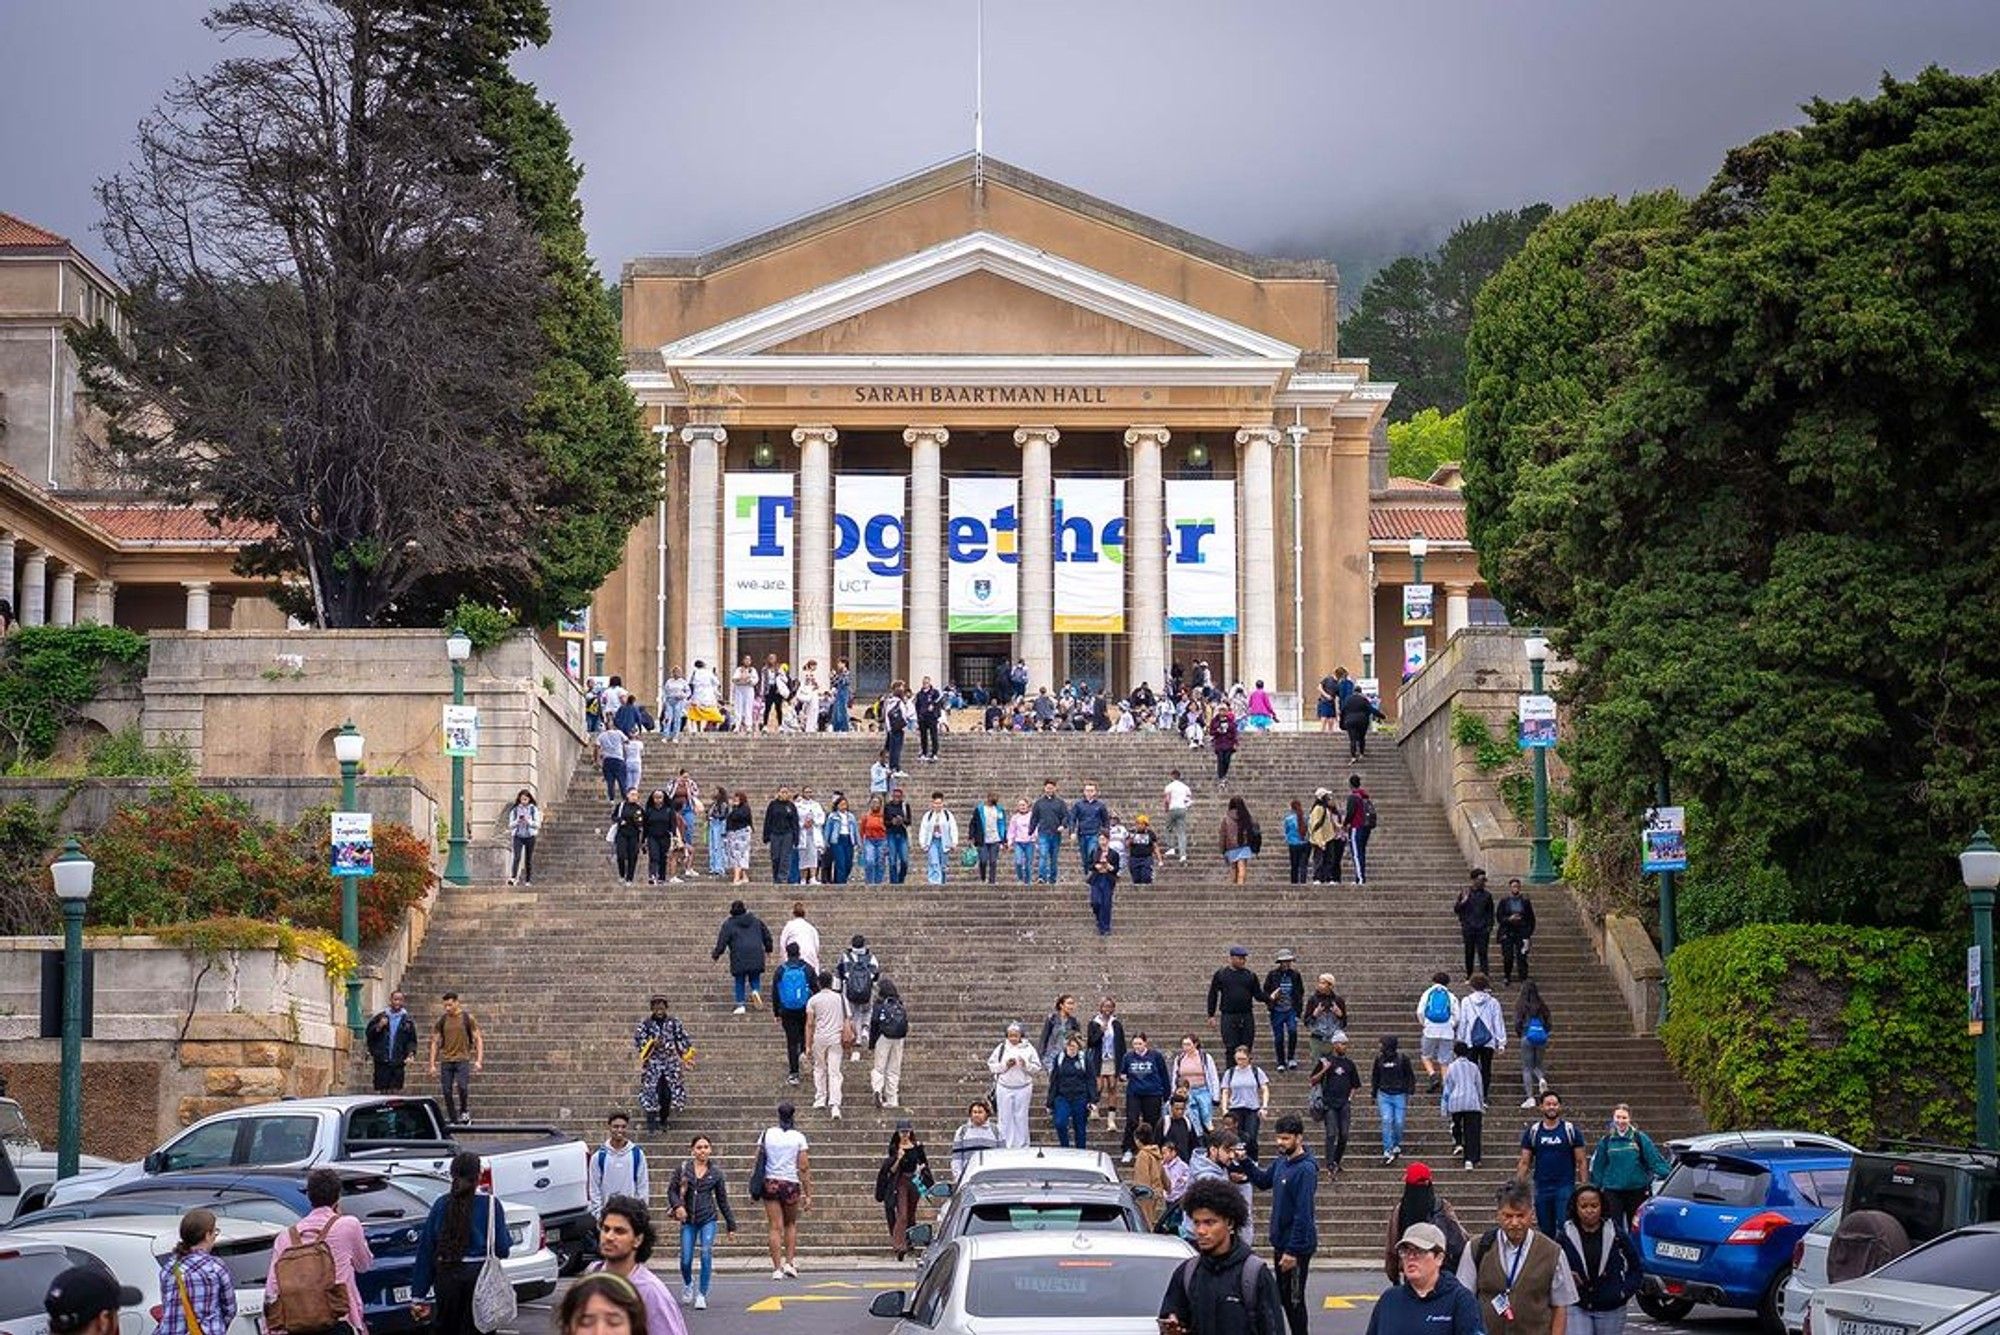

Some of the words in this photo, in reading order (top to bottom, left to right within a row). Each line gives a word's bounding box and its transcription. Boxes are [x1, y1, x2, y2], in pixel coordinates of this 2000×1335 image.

[855, 386, 924, 403] SARAH
[931, 386, 1045, 403] BAARTMAN
[1053, 386, 1107, 403] HALL
[737, 579, 758, 590] we
[761, 579, 787, 590] are
[838, 579, 871, 593] UCT
[1540, 1135, 1562, 1144] FILA
